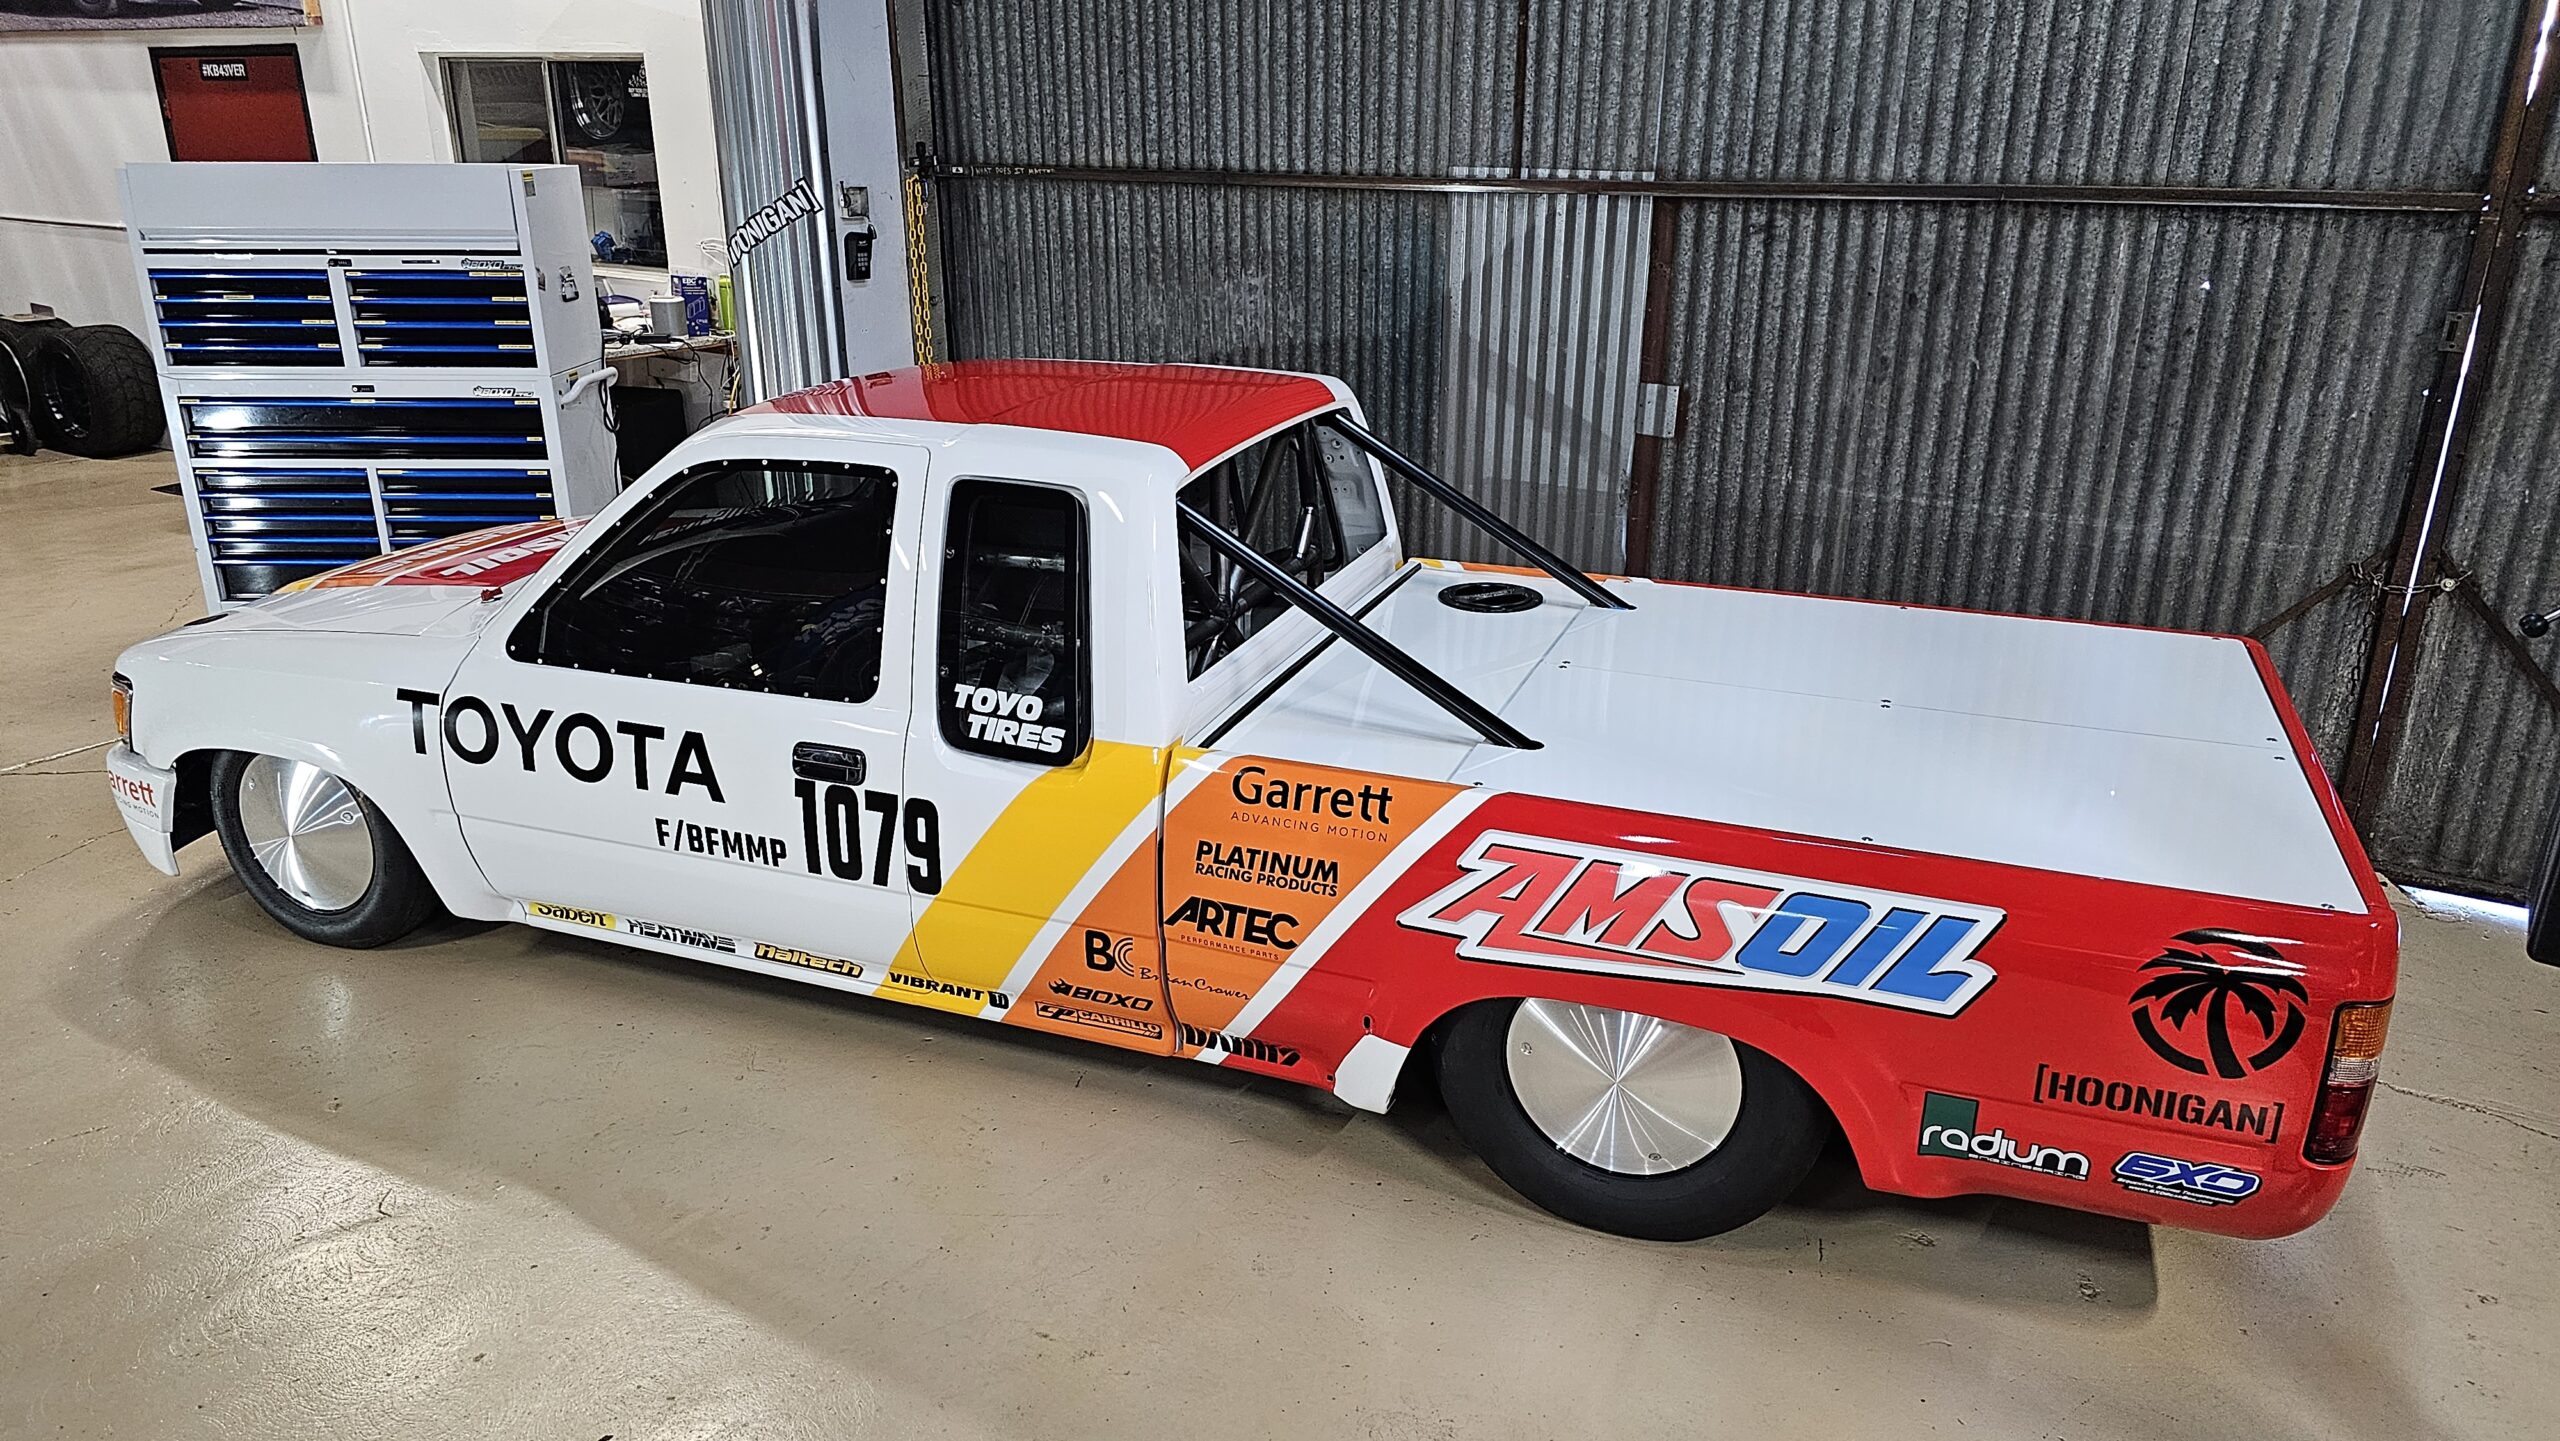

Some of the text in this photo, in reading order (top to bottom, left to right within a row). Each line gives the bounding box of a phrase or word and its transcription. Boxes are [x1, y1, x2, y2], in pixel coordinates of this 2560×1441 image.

[954, 683, 1044, 721] TOYO
[396, 687, 727, 804] TOYOTA
[967, 713, 1067, 753] TIRES
[108, 770, 157, 808] arrett
[1232, 766, 1393, 825] Garrett
[654, 817, 788, 868] F/BFMMP
[794, 777, 943, 896] 1079
[1230, 811, 1389, 843] ADVANCING MOTION
[1195, 840, 1339, 884] PLATINUM
[1195, 862, 1339, 897] RACING PRODUCTS
[626, 918, 737, 954] HEATWAVE
[1163, 896, 1300, 951] ARTEC
[1428, 842, 1982, 1003] AMSOIL
[755, 942, 863, 978] Haltech
[1085, 929, 1135, 978] BC
[1180, 934, 1280, 961] PERFORMANCE PARTS
[888, 971, 985, 1001] VIBRANT
[1071, 985, 1155, 1012] BOXO
[1077, 1010, 1162, 1034] CARRILLO
[2033, 1062, 2285, 1145] [HOONIGAN]
[1921, 1125, 2090, 1176] radium
